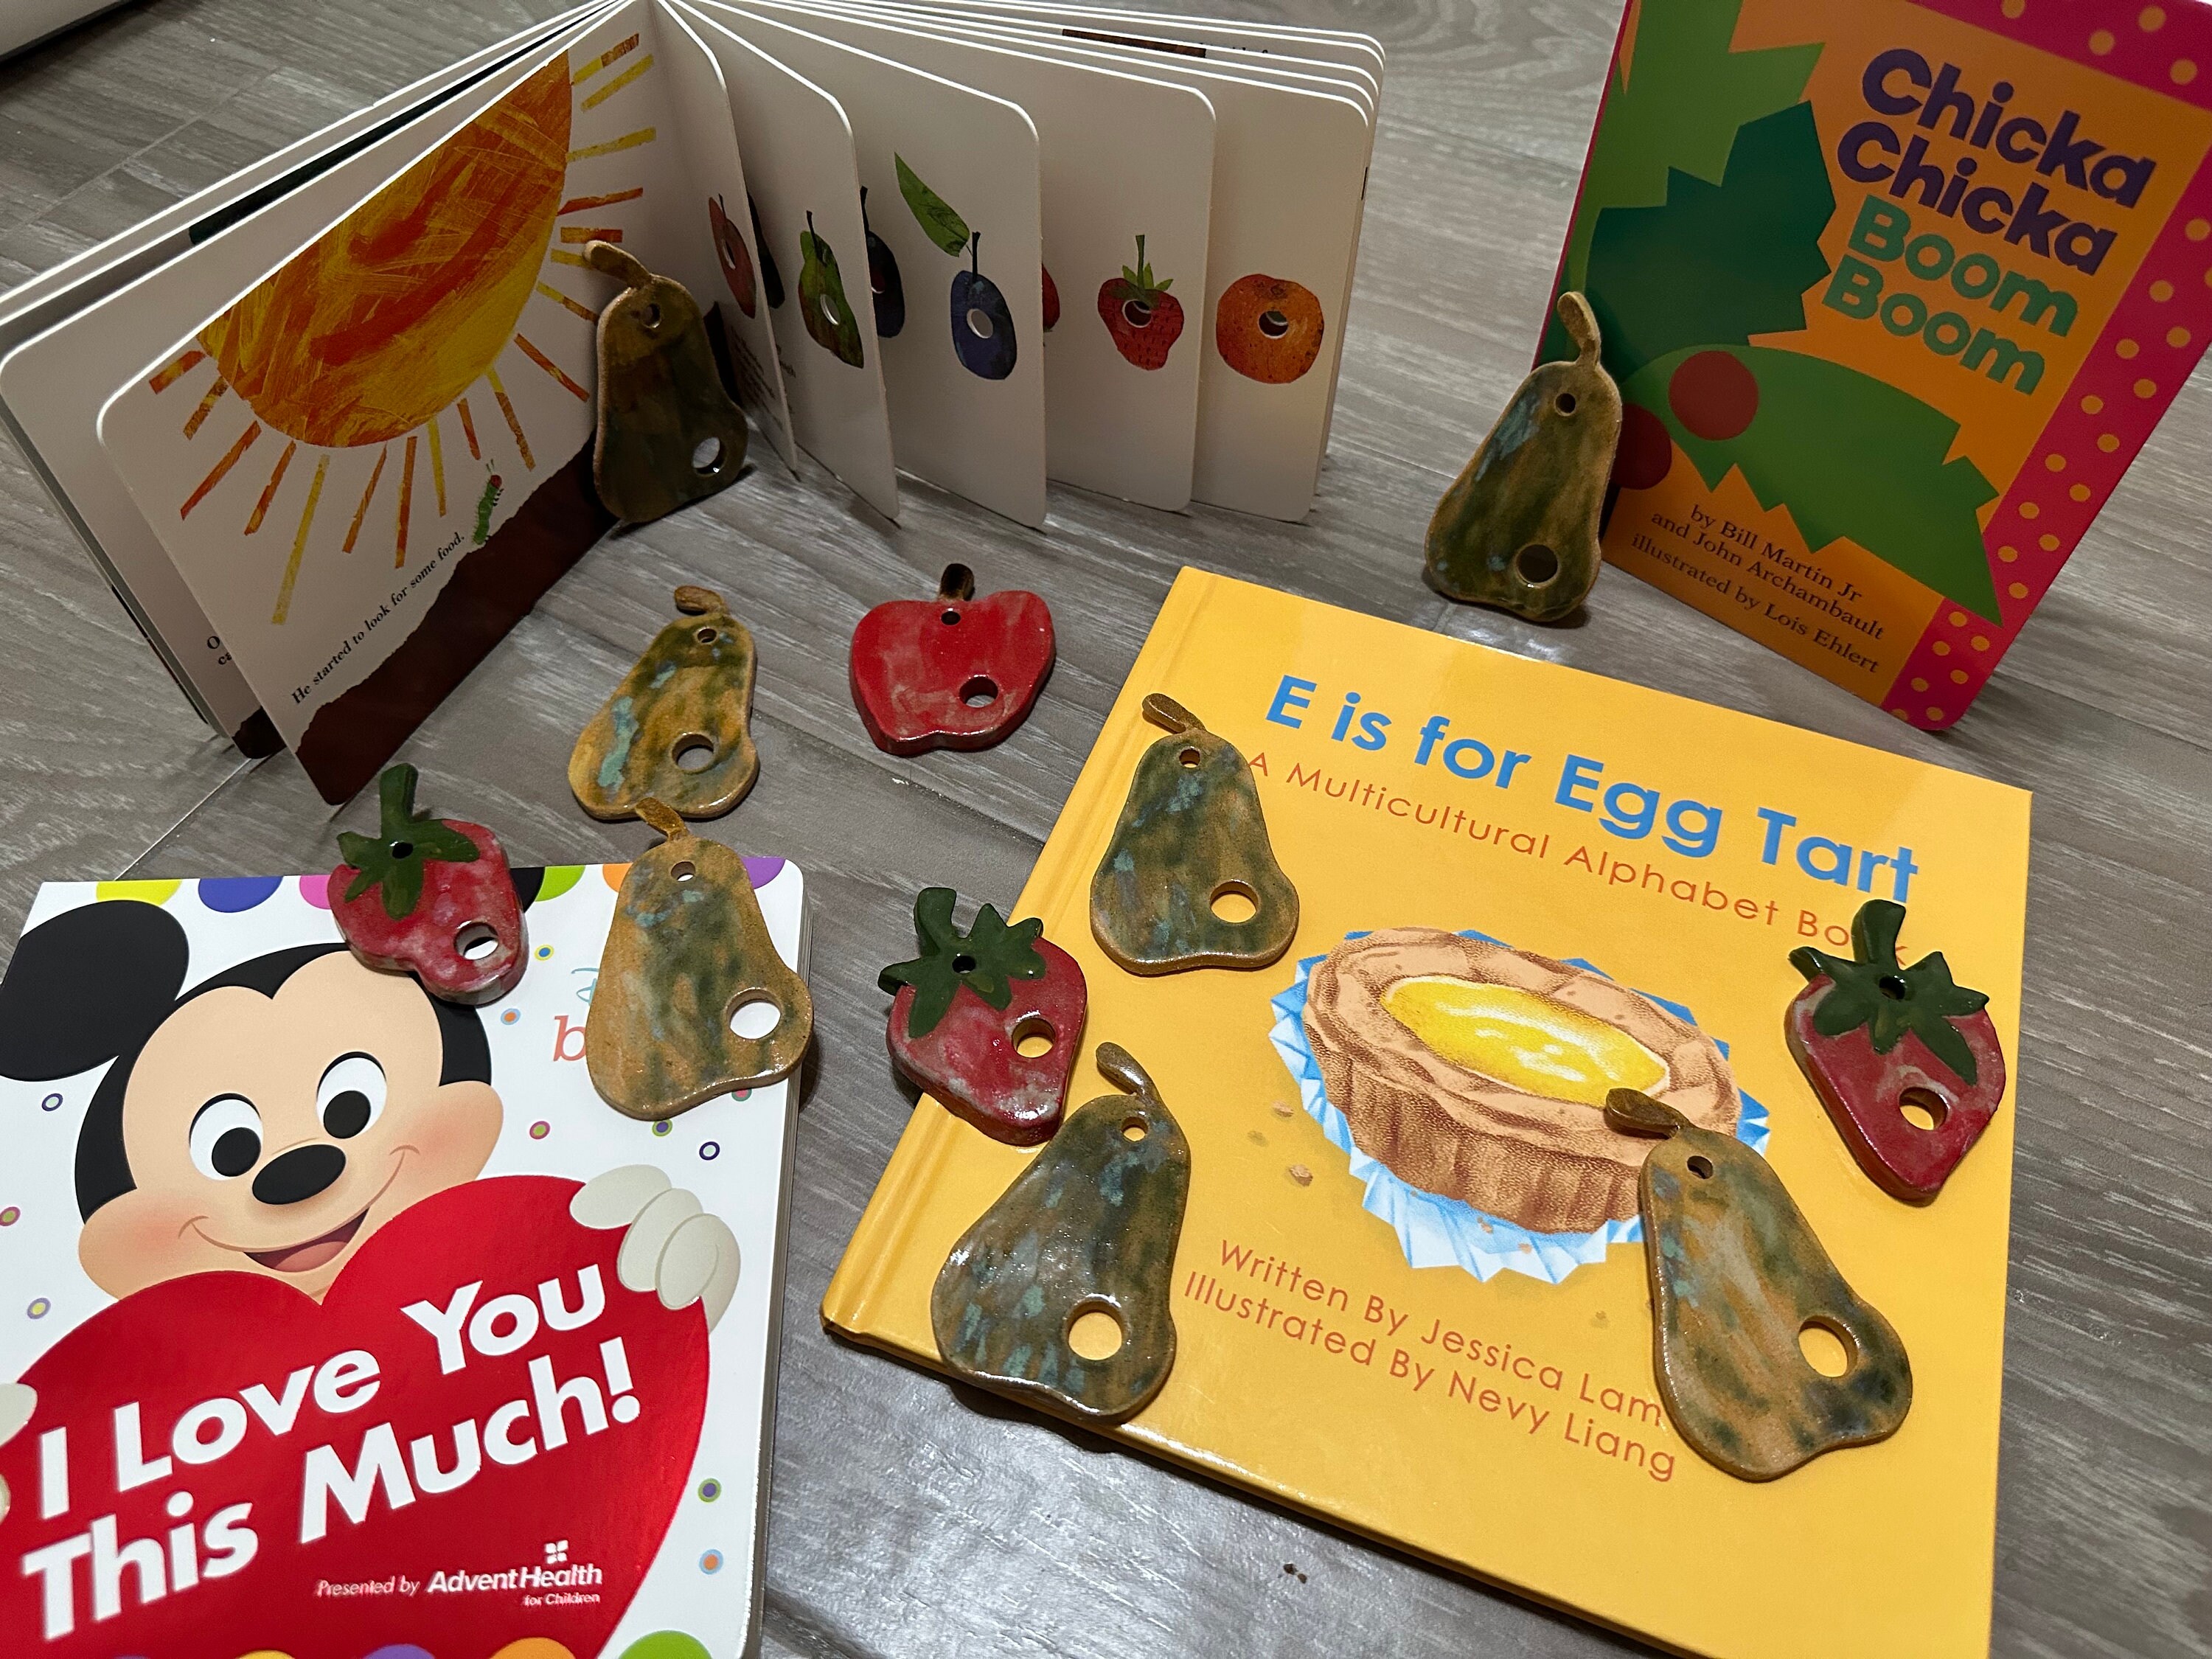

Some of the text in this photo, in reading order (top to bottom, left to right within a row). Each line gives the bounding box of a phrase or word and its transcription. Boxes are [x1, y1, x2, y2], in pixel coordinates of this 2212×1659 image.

[1837, 122, 2118, 275] Chicka
[1863, 49, 2157, 209] Chicka
[1821, 254, 2045, 395] Boom
[1848, 194, 2077, 336] Boom
[291, 532, 465, 704] He started to look for some food.
[1631, 534, 1879, 672] illustrated by Lois Ehlert
[1652, 512, 1884, 639] and John Archambault
[1691, 504, 1863, 602] by Bill Martin Jr
[1248, 752, 1268, 776] A
[1286, 762, 1549, 858] Multicultural
[1563, 845, 1778, 927] Alphabet
[1265, 675, 1919, 903] E is for Egg Tart
[38, 1263, 605, 1520] I Love You
[1184, 1271, 1675, 1481] Illustrated By Nevy Liang
[1219, 1239, 1662, 1427] Written By Jessica Lam
[22, 1337, 641, 1641] This Much!
[317, 1576, 394, 1597] Presented
[398, 1575, 420, 1596] by
[522, 1592, 599, 1607] for Children
